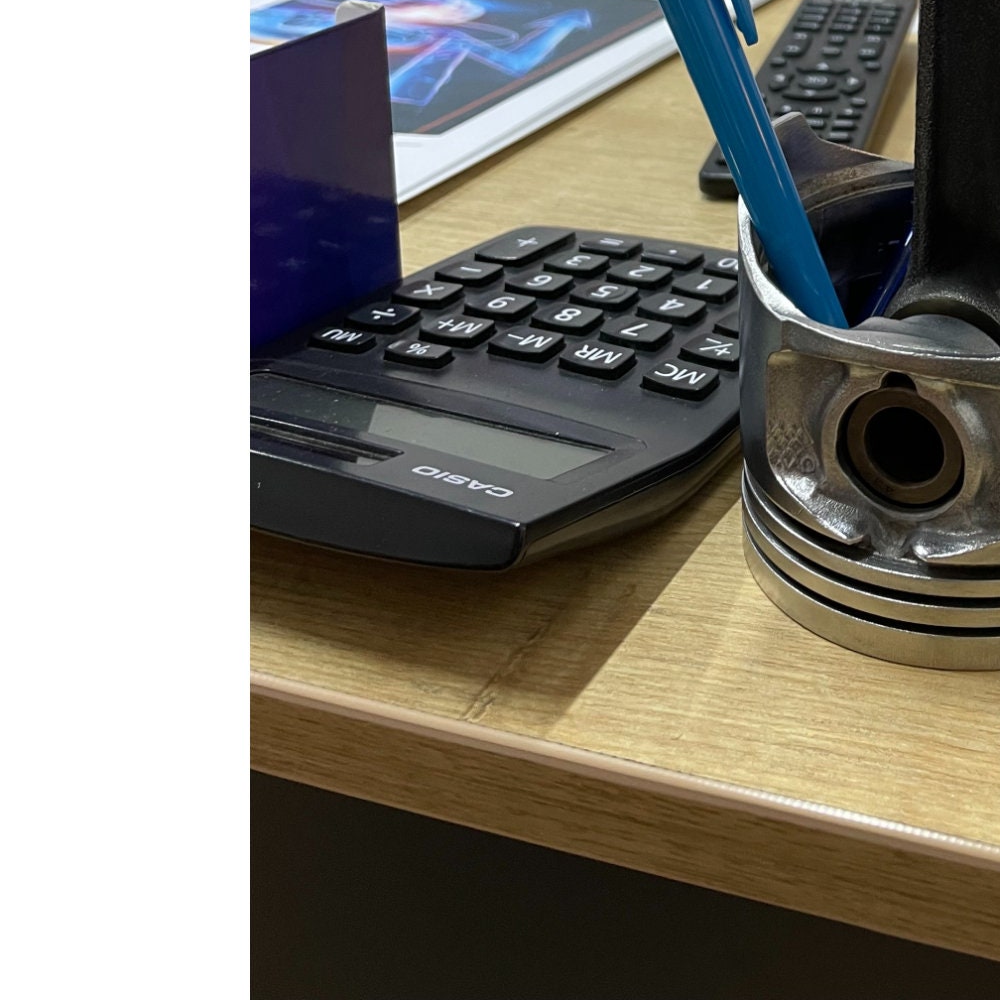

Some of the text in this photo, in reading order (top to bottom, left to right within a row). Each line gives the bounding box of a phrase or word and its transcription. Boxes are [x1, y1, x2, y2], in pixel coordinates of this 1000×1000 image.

[565, 255, 591, 266] 3
[628, 265, 655, 277] 2
[526, 275, 553, 286] 6
[696, 278, 713, 290] 1
[591, 285, 619, 297] 5
[487, 296, 515, 308] 9
[659, 298, 685, 311] 4
[554, 307, 582, 321] 8
[438, 319, 483, 334] M+
[620, 323, 648, 336] 7
[322, 329, 362, 342] MU
[574, 344, 623, 364] MR
[654, 363, 706, 385] MC
[411, 465, 514, 498] CASIO
